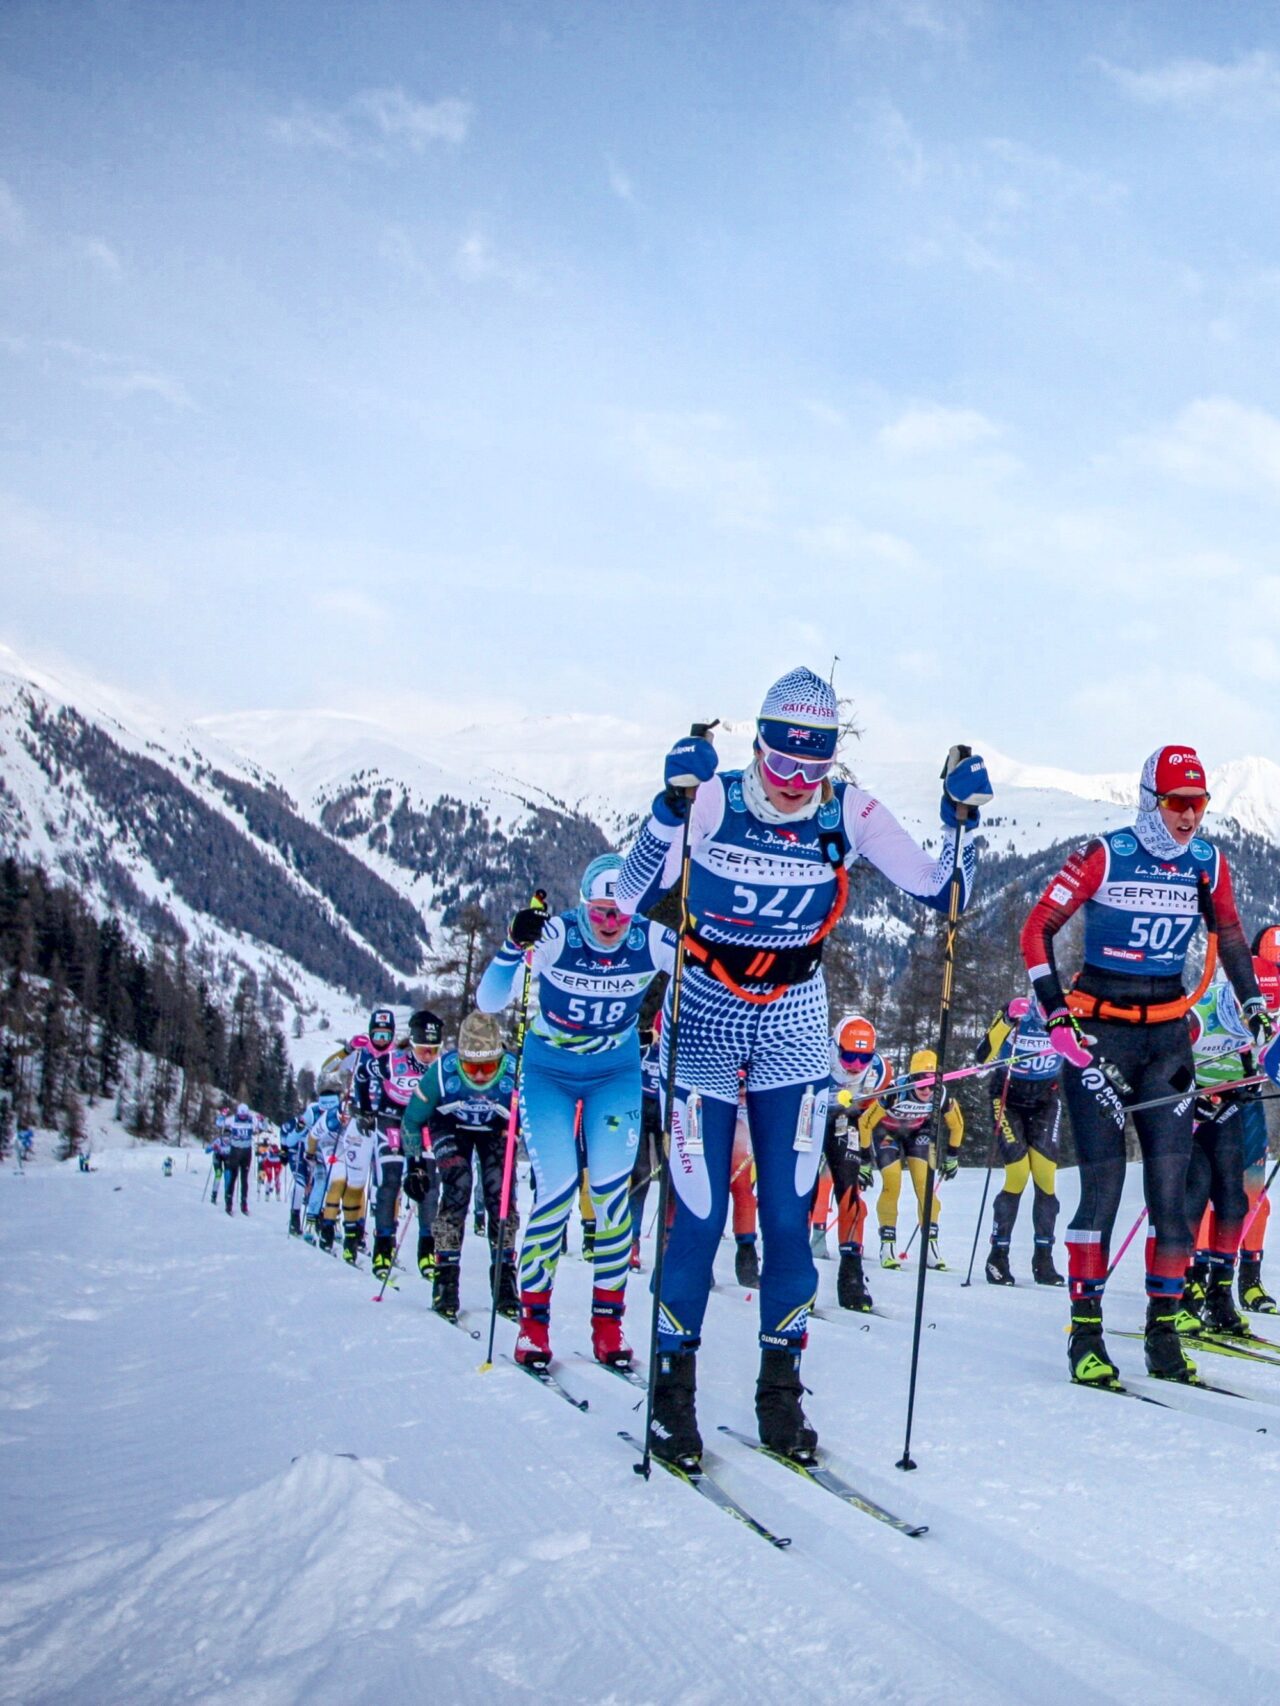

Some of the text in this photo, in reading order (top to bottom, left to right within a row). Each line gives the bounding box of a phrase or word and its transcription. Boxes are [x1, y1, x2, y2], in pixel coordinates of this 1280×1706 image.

[758, 869, 825, 877] WATCHES
[1134, 864, 1148, 874] La
[1108, 887, 1200, 902] CERTINA
[1151, 901, 1195, 910] WATCHE
[1128, 917, 1194, 950] 507
[550, 970, 636, 990] CERTINA
[567, 998, 627, 1025] 518
[1012, 1034, 1051, 1048] ERTIN
[671, 1110, 693, 1174] RAIFFESEN
[761, 1334, 789, 1347] OVENTO
